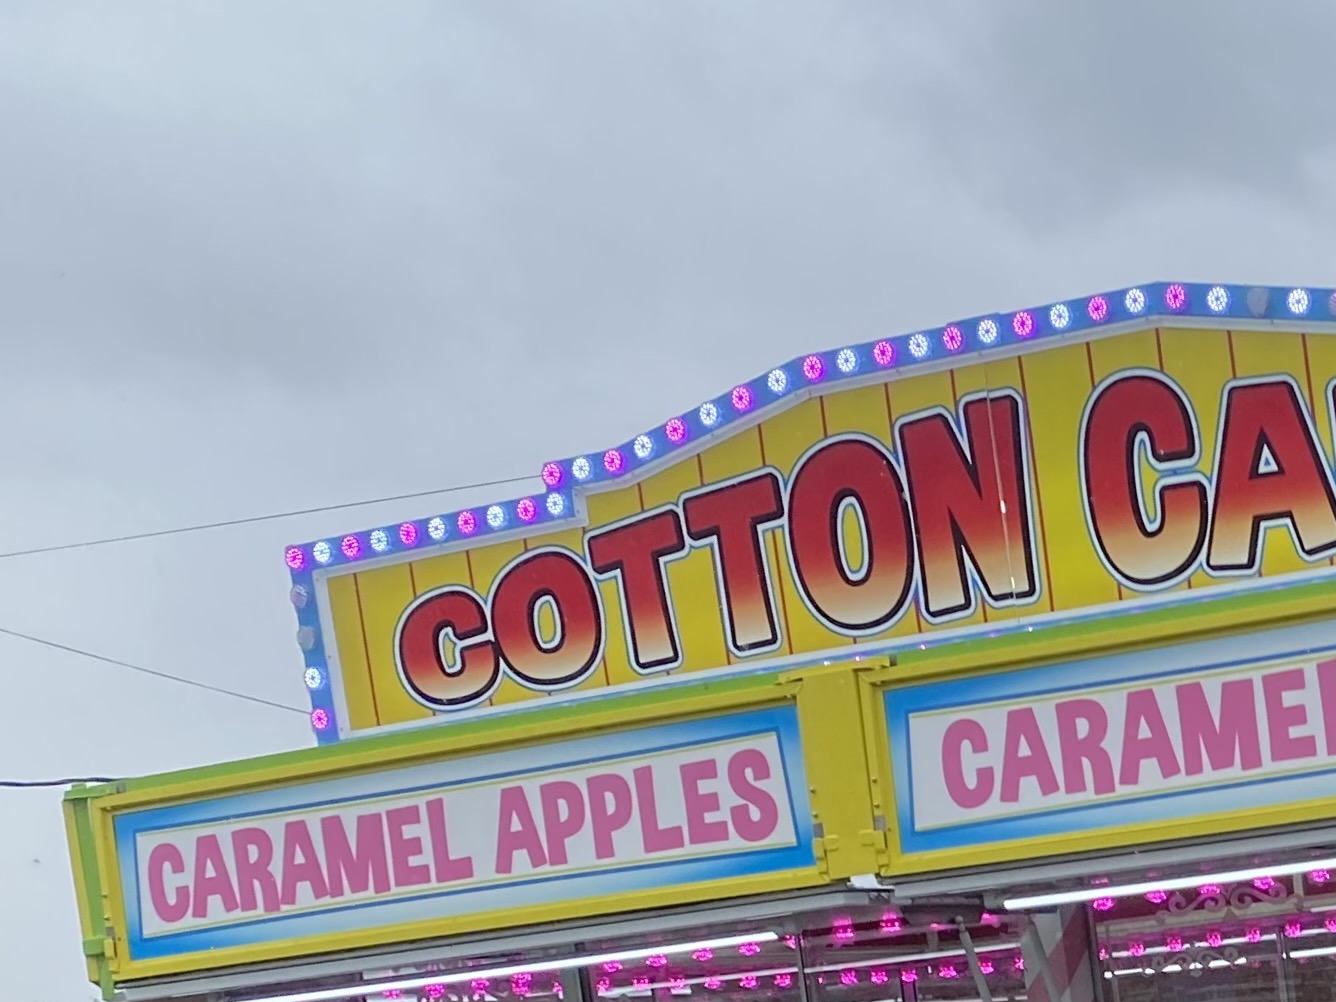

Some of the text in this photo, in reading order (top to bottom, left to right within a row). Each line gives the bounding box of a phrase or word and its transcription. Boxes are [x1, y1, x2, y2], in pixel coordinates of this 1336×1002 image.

[394, 388, 1041, 711] COTTON
[147, 748, 780, 924] CARAMEL APPLES
